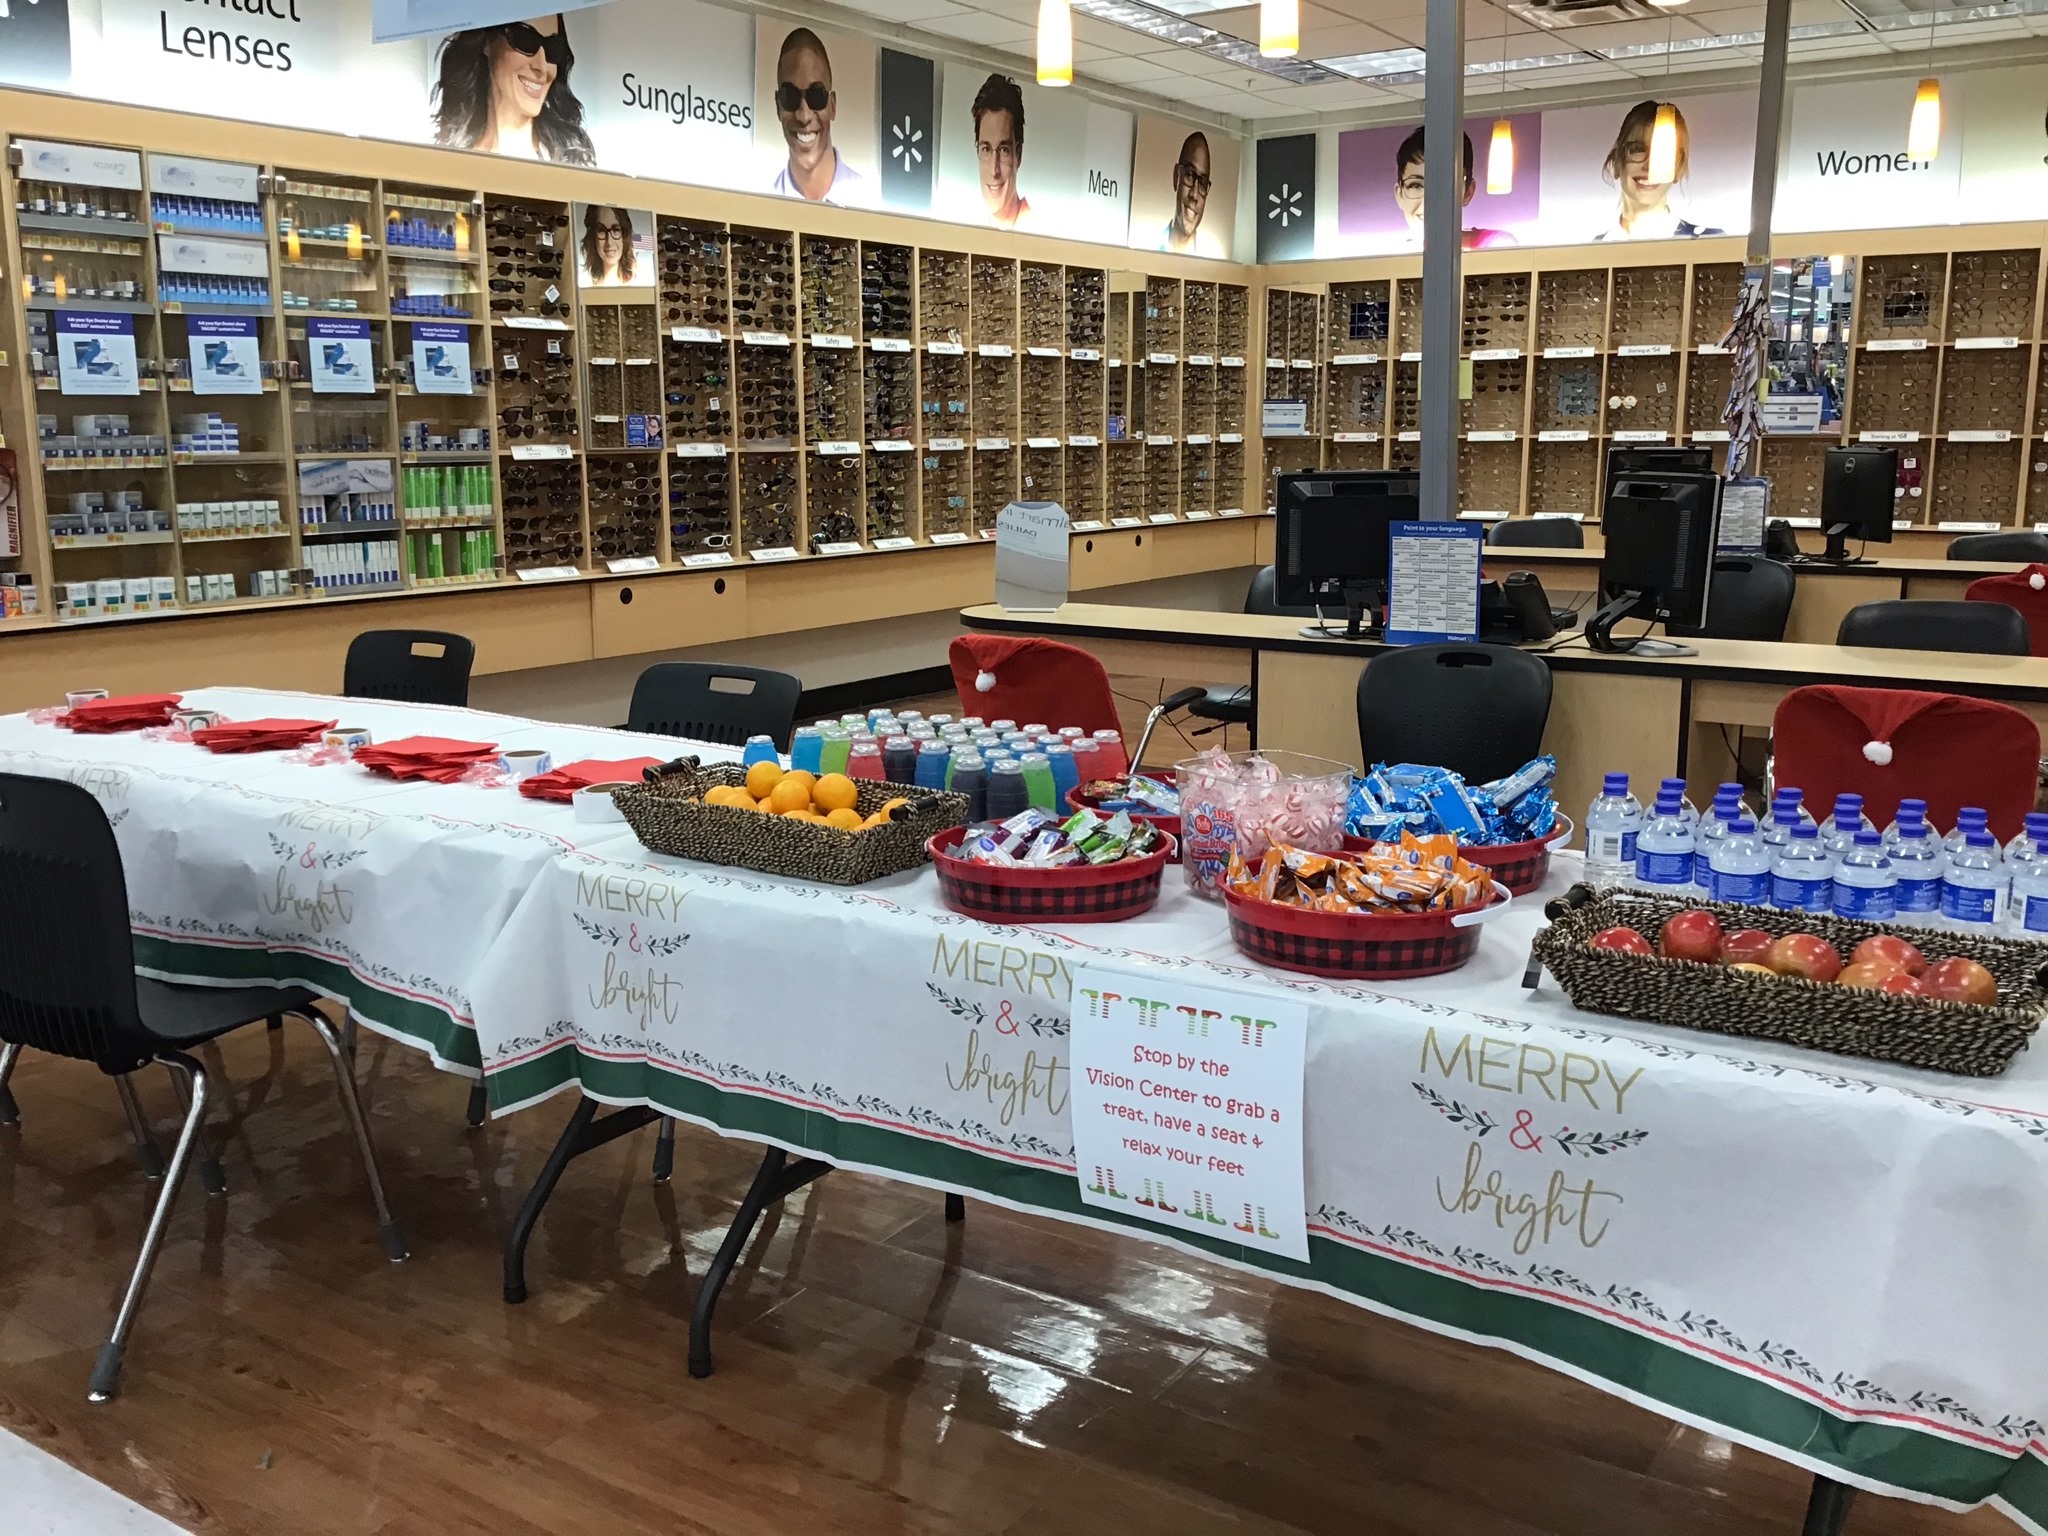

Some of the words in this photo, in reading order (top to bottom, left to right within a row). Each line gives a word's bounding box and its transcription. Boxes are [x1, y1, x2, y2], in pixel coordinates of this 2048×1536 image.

[161, 10, 292, 72] Lenses
[622, 72, 752, 129] Sunglasses
[1088, 169, 1118, 198] Men
[825, 337, 840, 346] Safety
[884, 341, 897, 350] Safety
[7, 505, 19, 554] MAGNIFIER
[300, 841, 317, 869] &
[263, 865, 354, 933] bright
[576, 870, 695, 923] MERRY
[628, 922, 644, 956] &
[588, 951, 684, 1031] bright
[931, 933, 1080, 1002] MERRY
[995, 1000, 1020, 1037] &
[946, 1028, 1071, 1127] bright
[1133, 1044, 1172, 1067] Stop
[1177, 1053, 1195, 1072] by
[1200, 1058, 1229, 1078] the
[1420, 1026, 1645, 1115] MERRY
[1086, 1067, 1134, 1091] Vision
[1139, 1079, 1198, 1104] Center
[1202, 1093, 1222, 1109] to
[1227, 1098, 1265, 1119] grab
[1270, 1108, 1280, 1123] a
[1102, 1102, 1148, 1125] treat,
[1154, 1110, 1192, 1133] have
[1196, 1122, 1206, 1137] a
[1211, 1126, 1247, 1146] seat
[1252, 1134, 1264, 1149] &
[1509, 1109, 1543, 1153] &
[1122, 1136, 1162, 1157] relax
[1166, 1145, 1203, 1167] your
[1207, 1155, 1245, 1177] feet
[1437, 1141, 1624, 1256] bright
